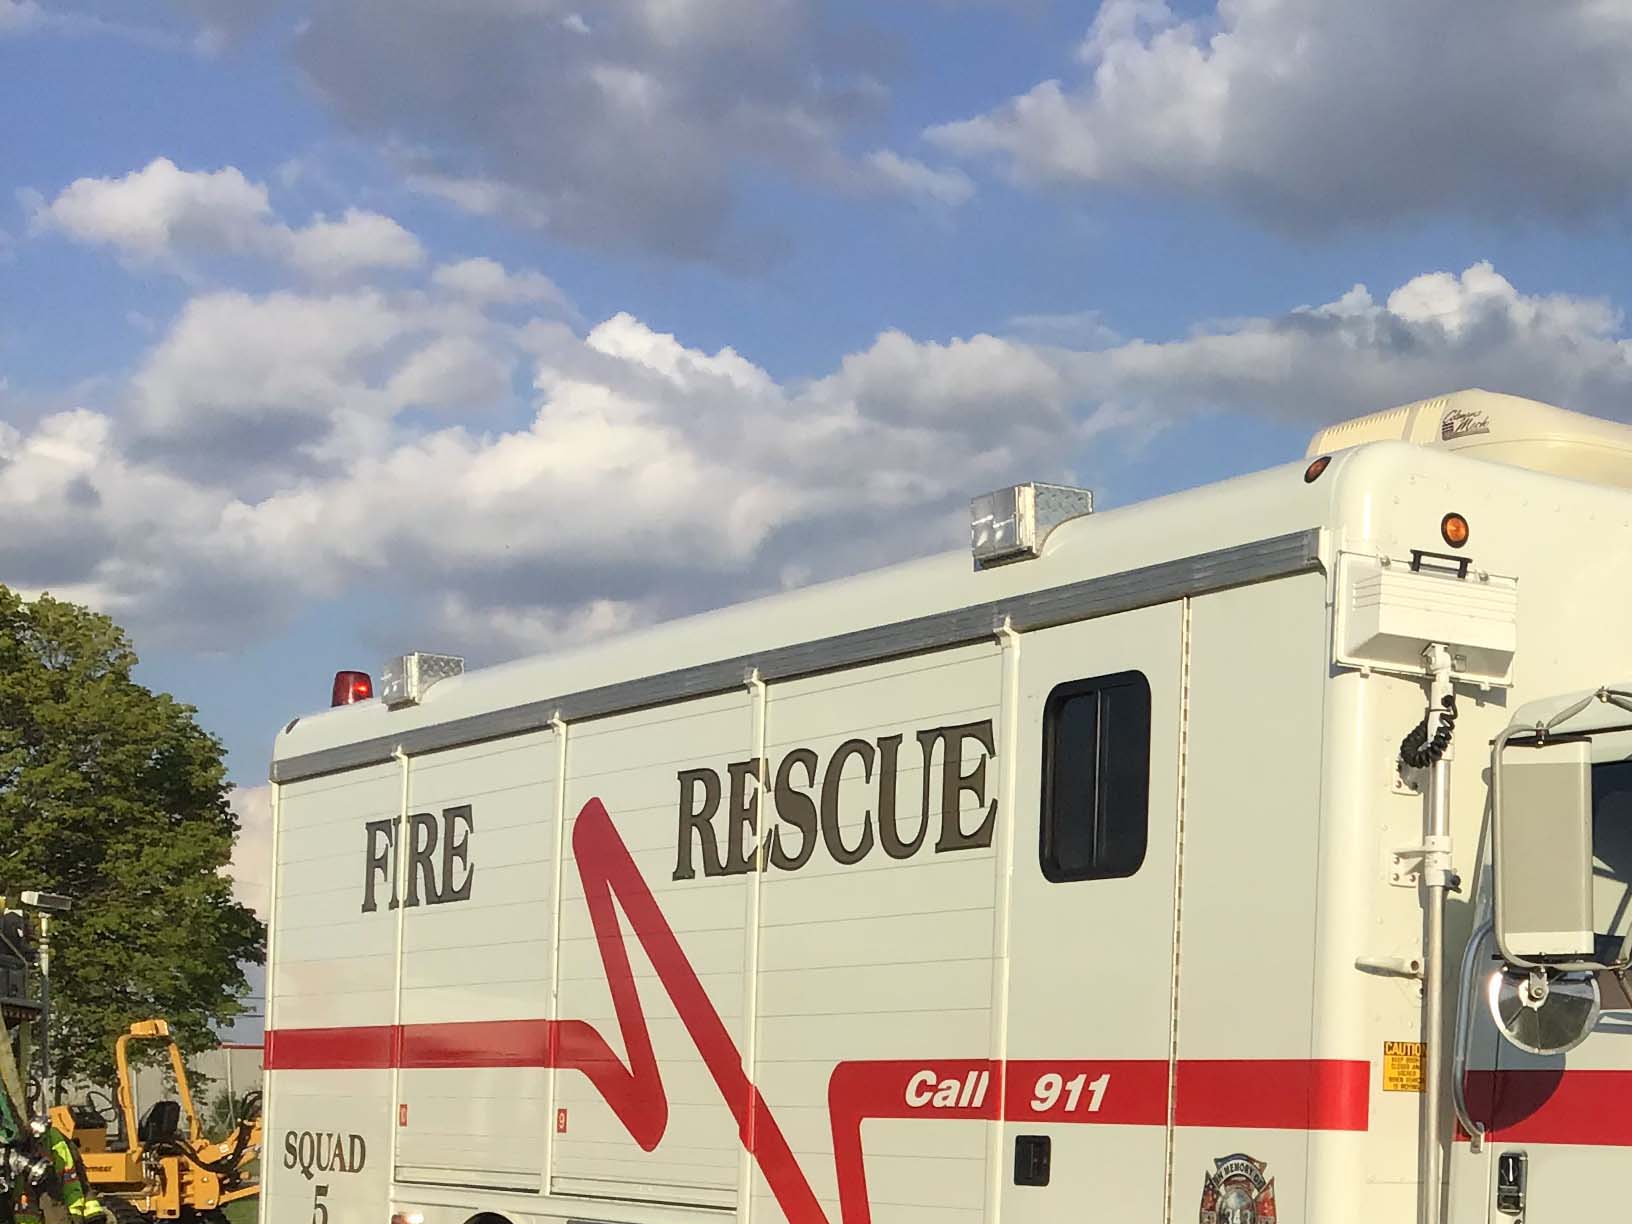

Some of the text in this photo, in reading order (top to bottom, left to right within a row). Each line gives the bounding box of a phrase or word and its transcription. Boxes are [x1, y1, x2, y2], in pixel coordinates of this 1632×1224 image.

[672, 719, 998, 881] RESCUE
[362, 804, 474, 913] FIRE
[905, 1070, 1111, 1112] Call 911
[284, 1131, 366, 1180] SQUAD
[1224, 1162, 1253, 1175] MEMORY
